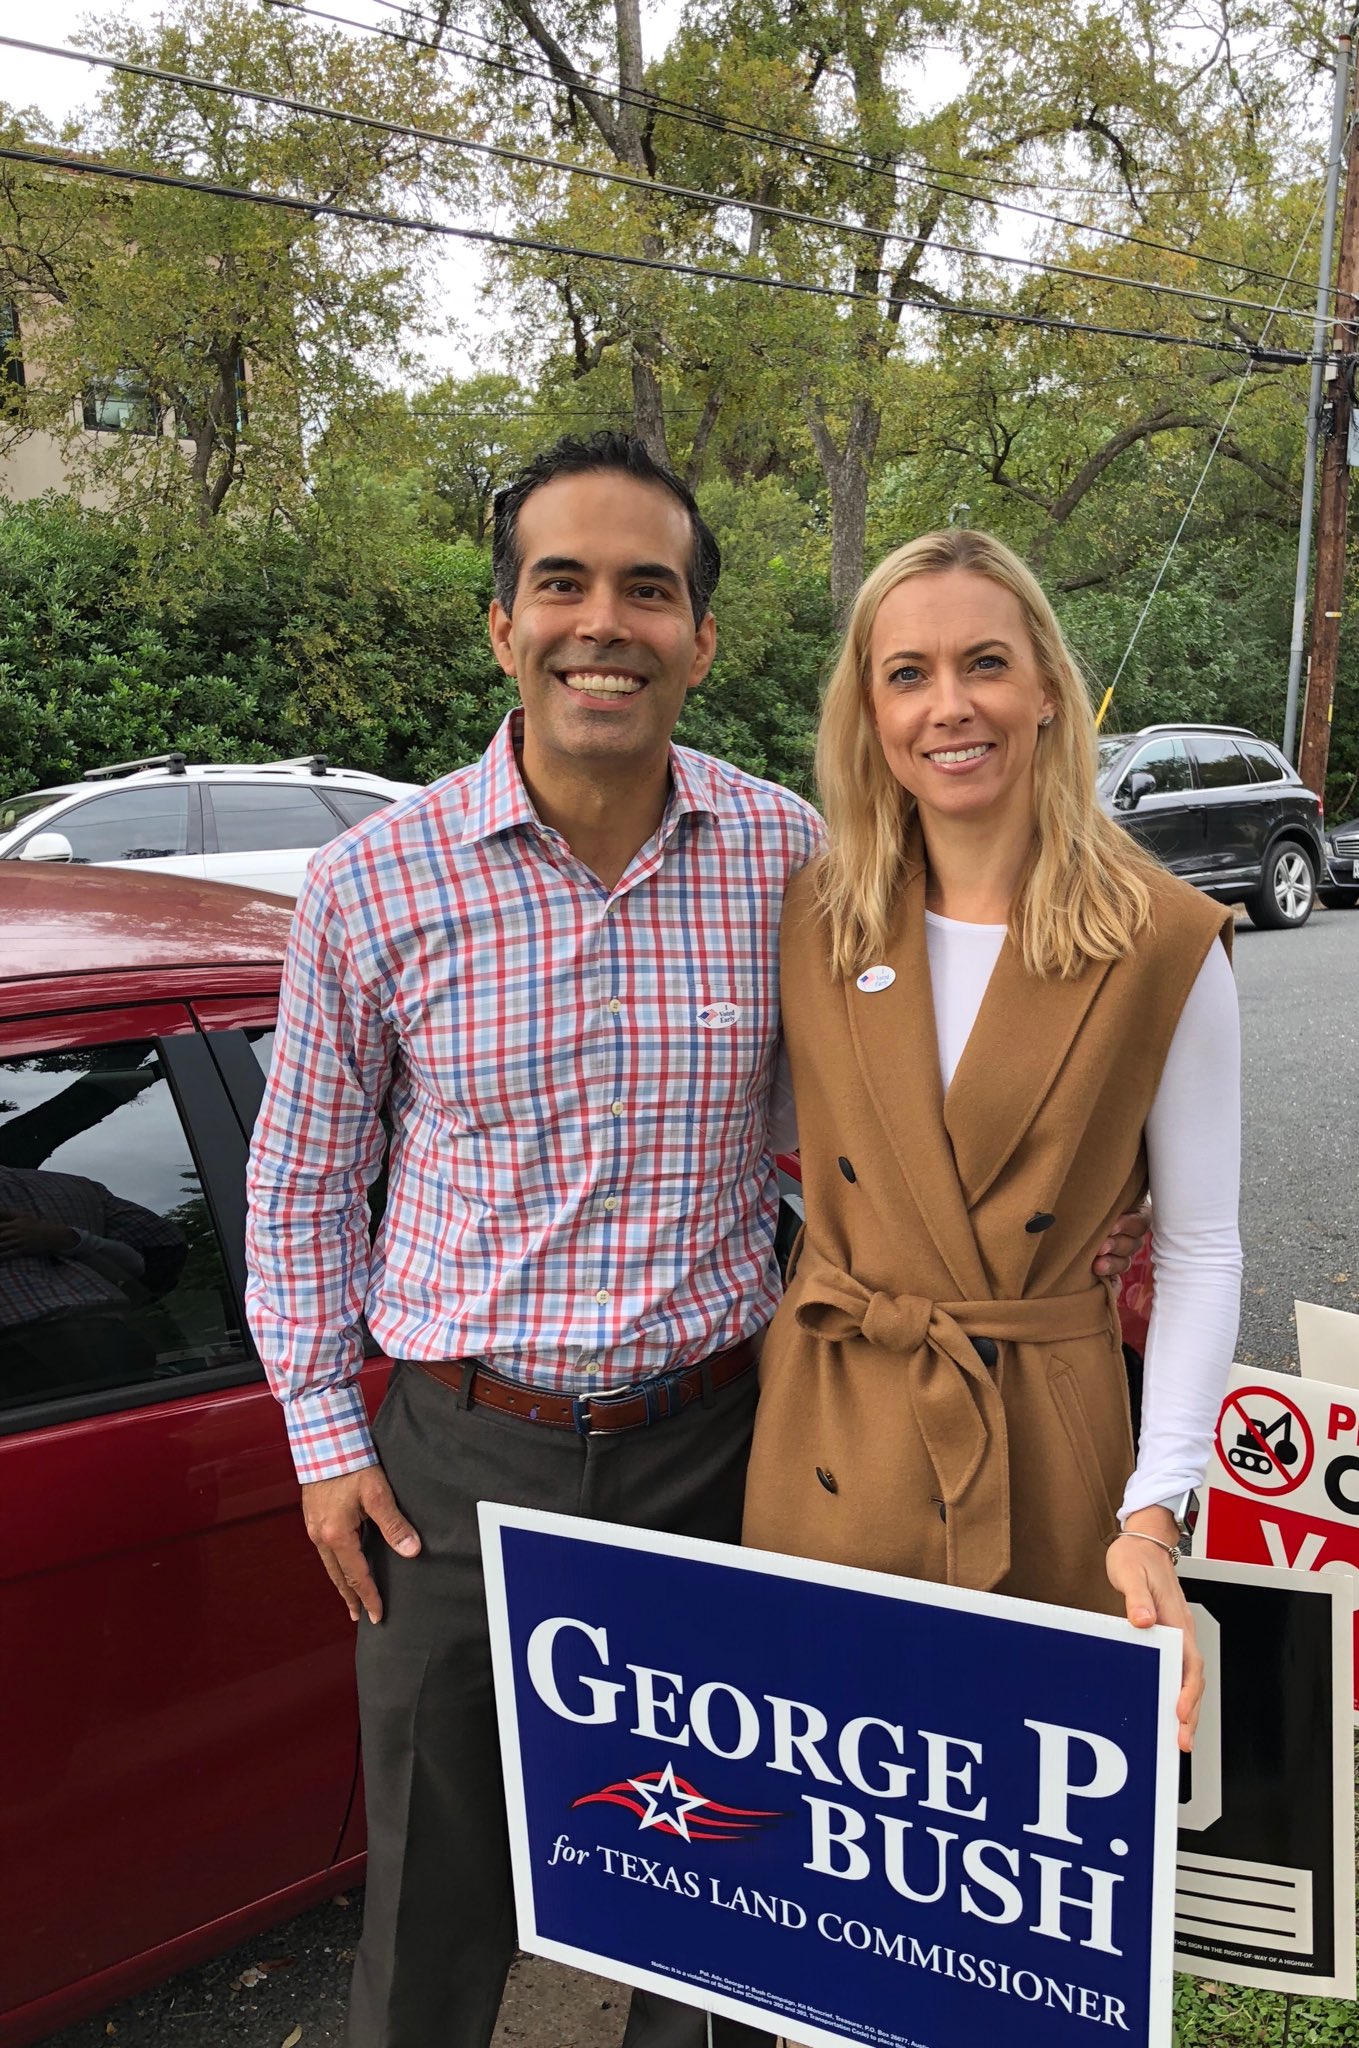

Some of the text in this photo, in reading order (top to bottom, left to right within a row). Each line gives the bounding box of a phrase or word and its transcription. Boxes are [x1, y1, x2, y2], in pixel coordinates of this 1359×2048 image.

[527, 1617, 987, 1822] GEORGE
[1023, 1718, 1129, 1856] P.
[547, 1834, 1130, 2031] for TEXAS LAND COMMISSIONER
[801, 1794, 1125, 1957] BUSH
[1187, 1941, 1203, 1950] SIGN
[1203, 1944, 1210, 1952] IN
[1210, 1946, 1223, 1955] THE
[1268, 1956, 1278, 1964] OF
[751, 1986, 766, 1996] Bush
